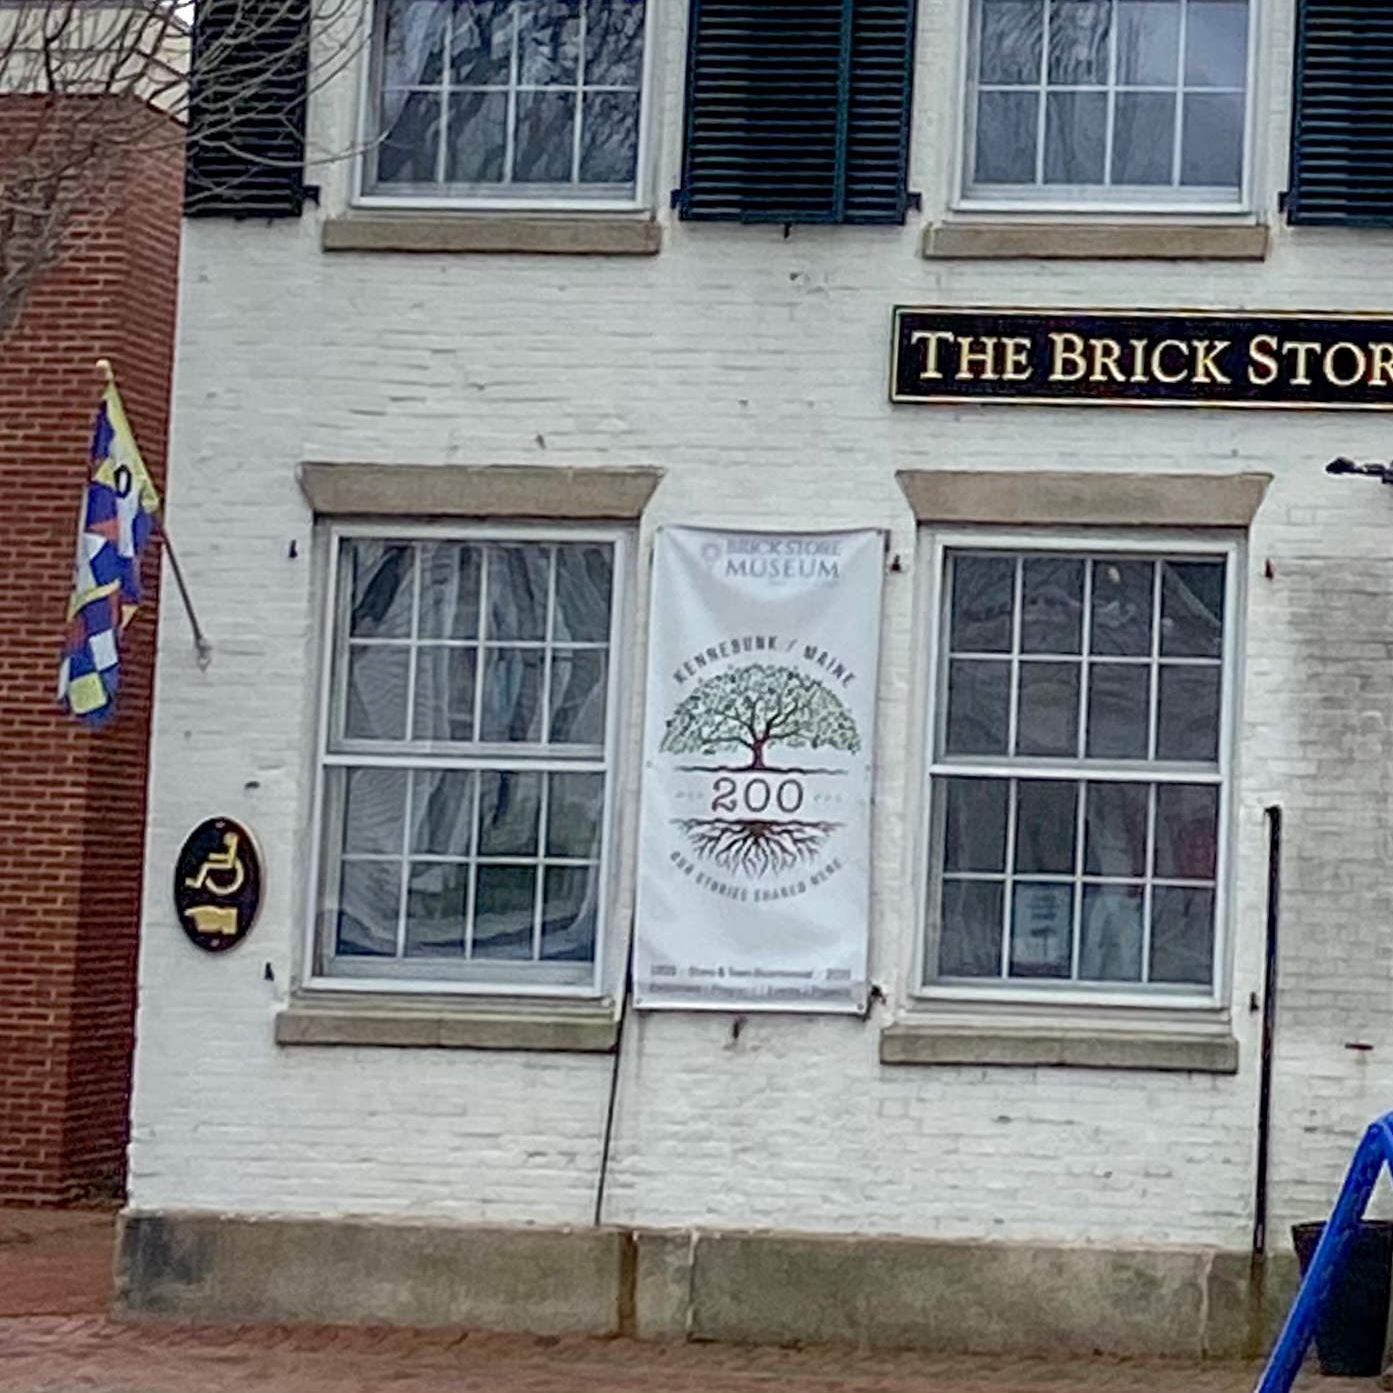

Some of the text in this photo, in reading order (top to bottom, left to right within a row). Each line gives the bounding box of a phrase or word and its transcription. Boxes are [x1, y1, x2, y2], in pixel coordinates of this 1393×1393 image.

[725, 558, 840, 579] MUSEUM
[673, 635, 778, 684] KENNEBUNK
[803, 645, 856, 688] MAINE
[711, 777, 804, 813] 200
